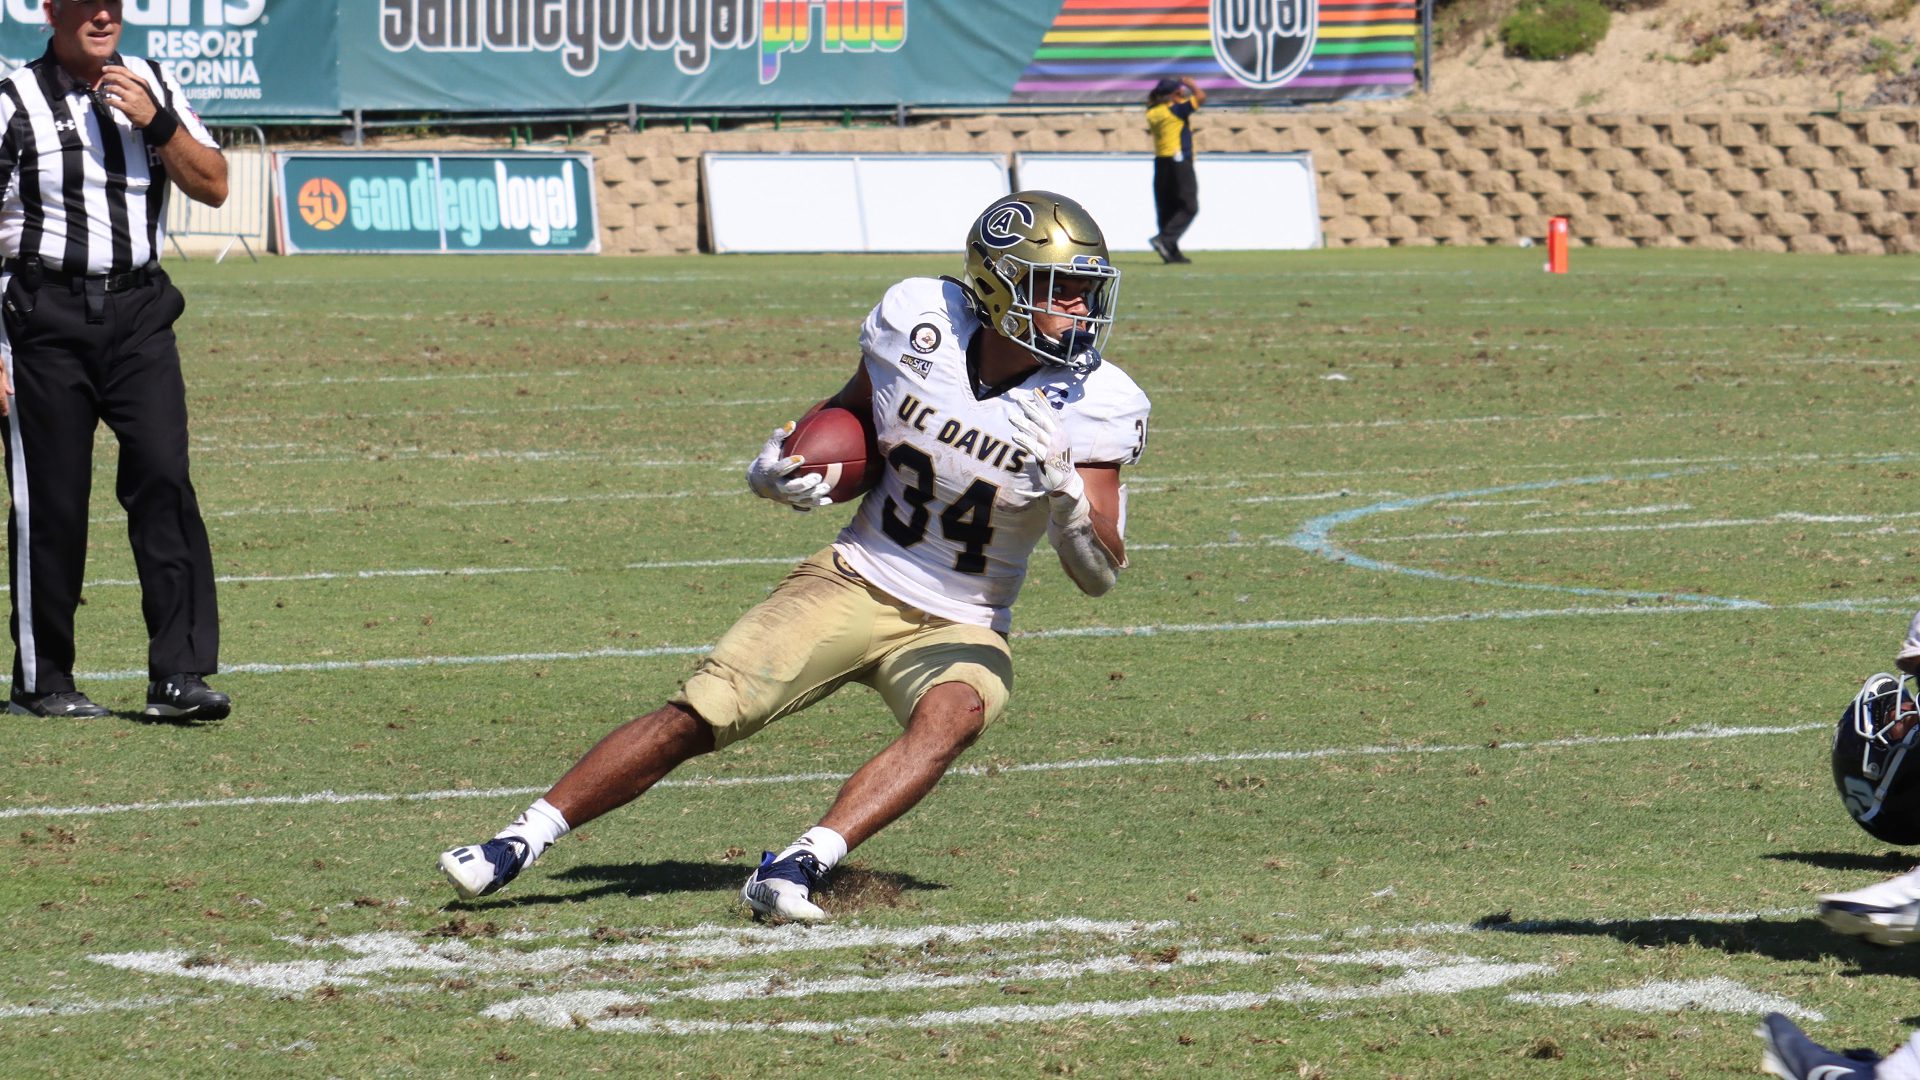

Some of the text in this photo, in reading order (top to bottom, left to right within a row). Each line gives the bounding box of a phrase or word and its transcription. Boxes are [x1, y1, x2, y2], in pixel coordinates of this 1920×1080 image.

[147, 30, 258, 59] RESORT
[164, 60, 261, 85] FORNIA
[224, 88, 262, 99] INDIANS
[897, 393, 1031, 474] UC DAVIS
[882, 442, 1002, 575] 34
